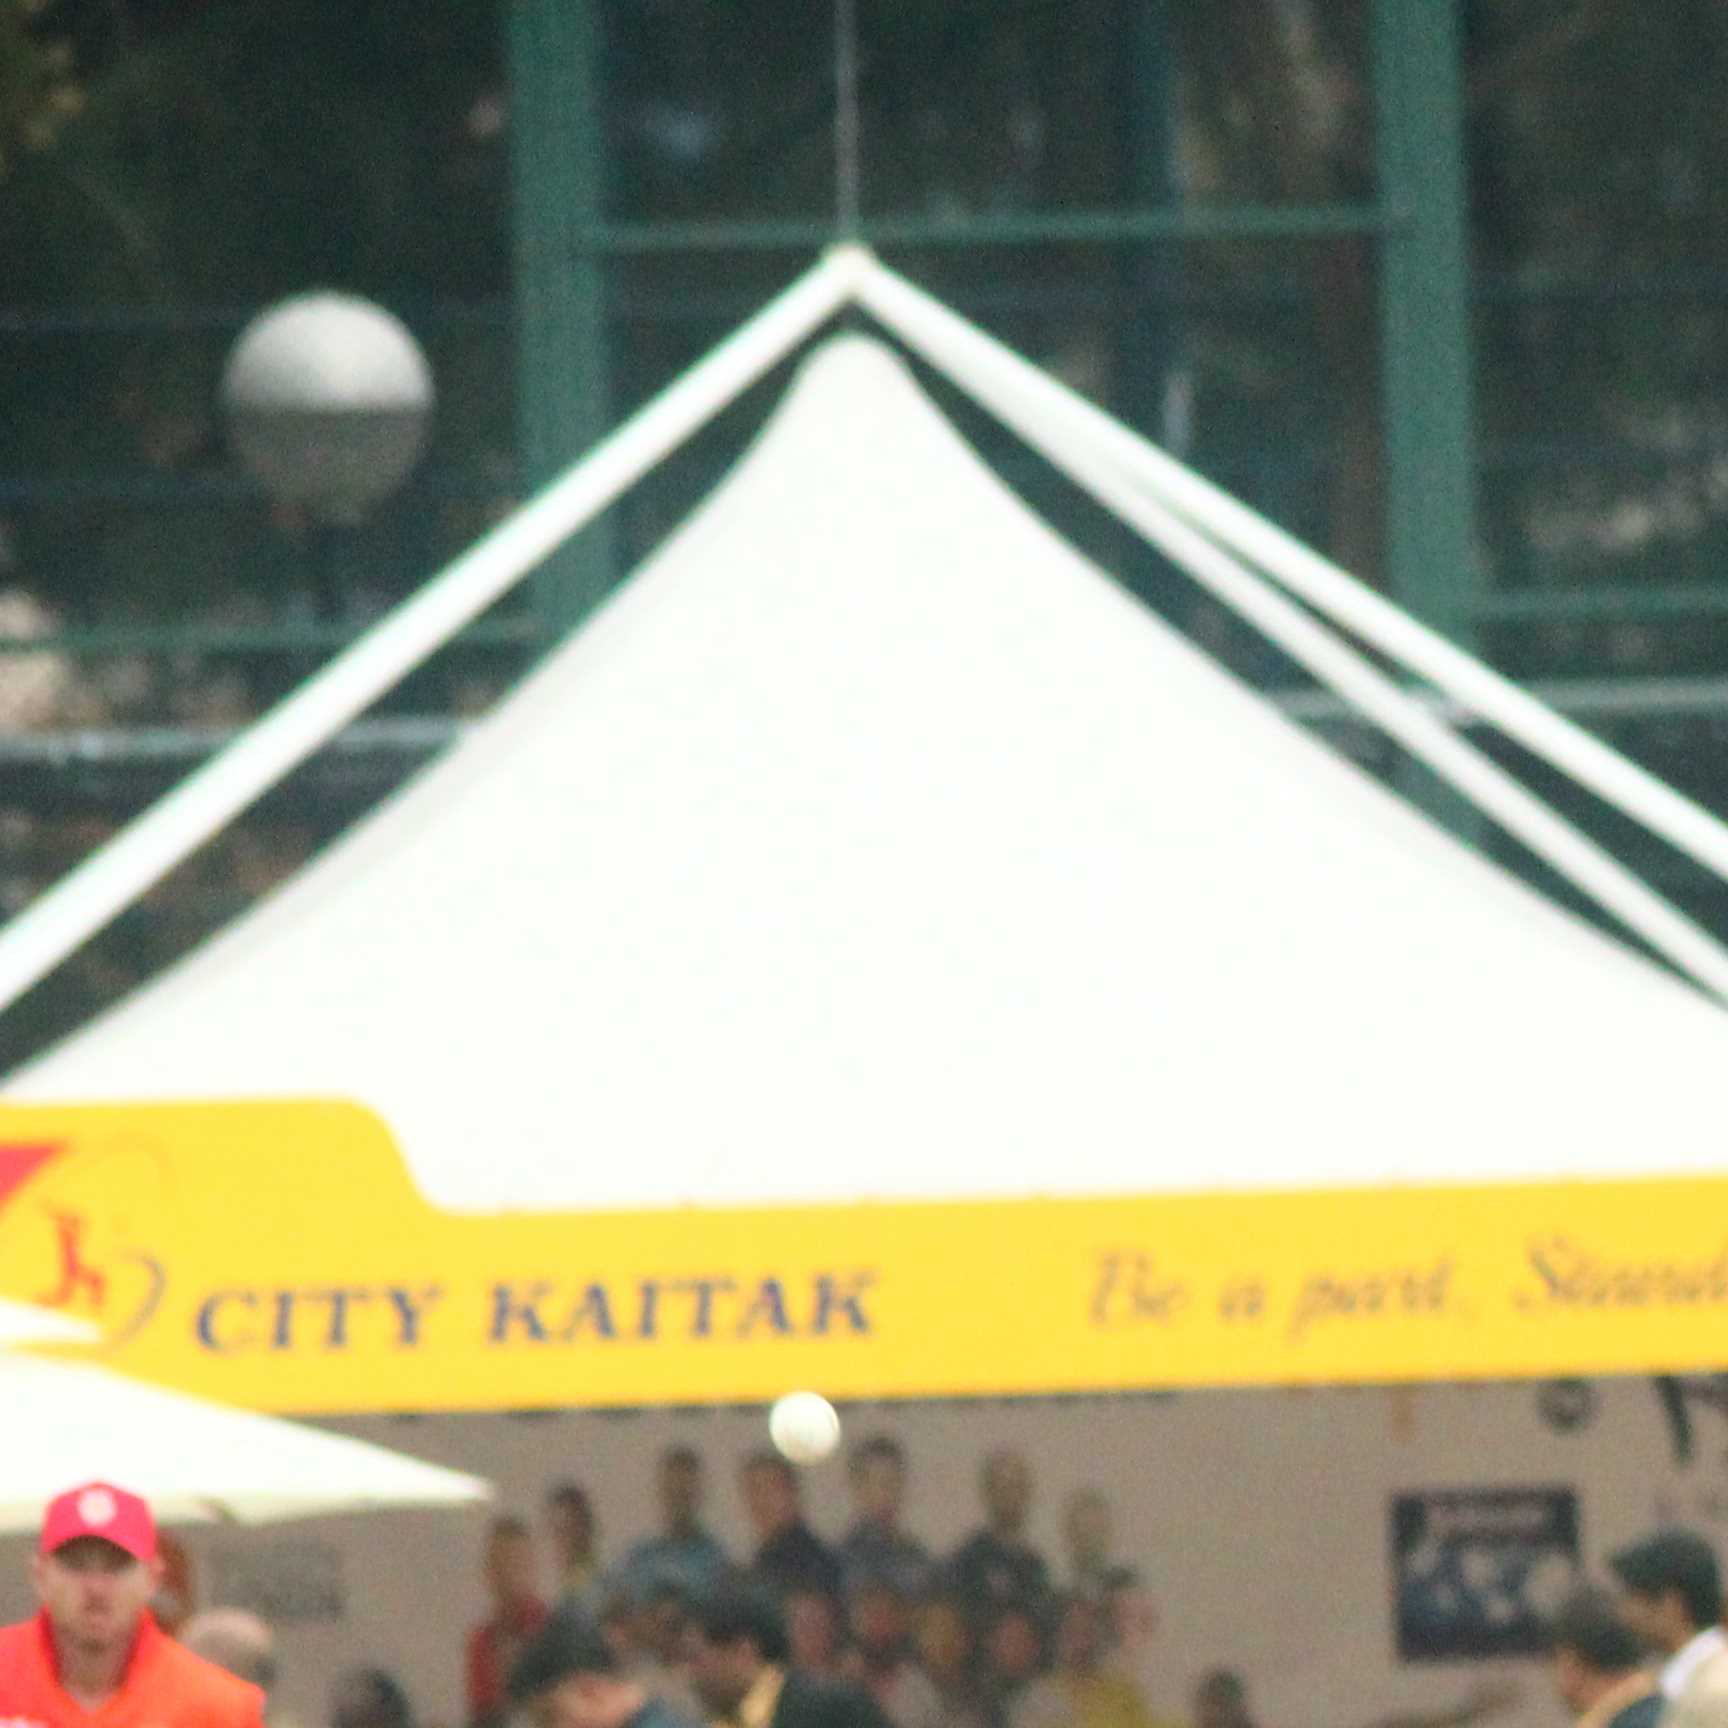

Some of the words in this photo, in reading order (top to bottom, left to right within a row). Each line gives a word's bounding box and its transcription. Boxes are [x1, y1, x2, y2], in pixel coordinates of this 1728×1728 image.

[194, 1283, 446, 1354] CITY
[484, 1269, 882, 1346] KAITAK
[1090, 1246, 1192, 1332] Be
[1217, 1273, 1269, 1325] a
